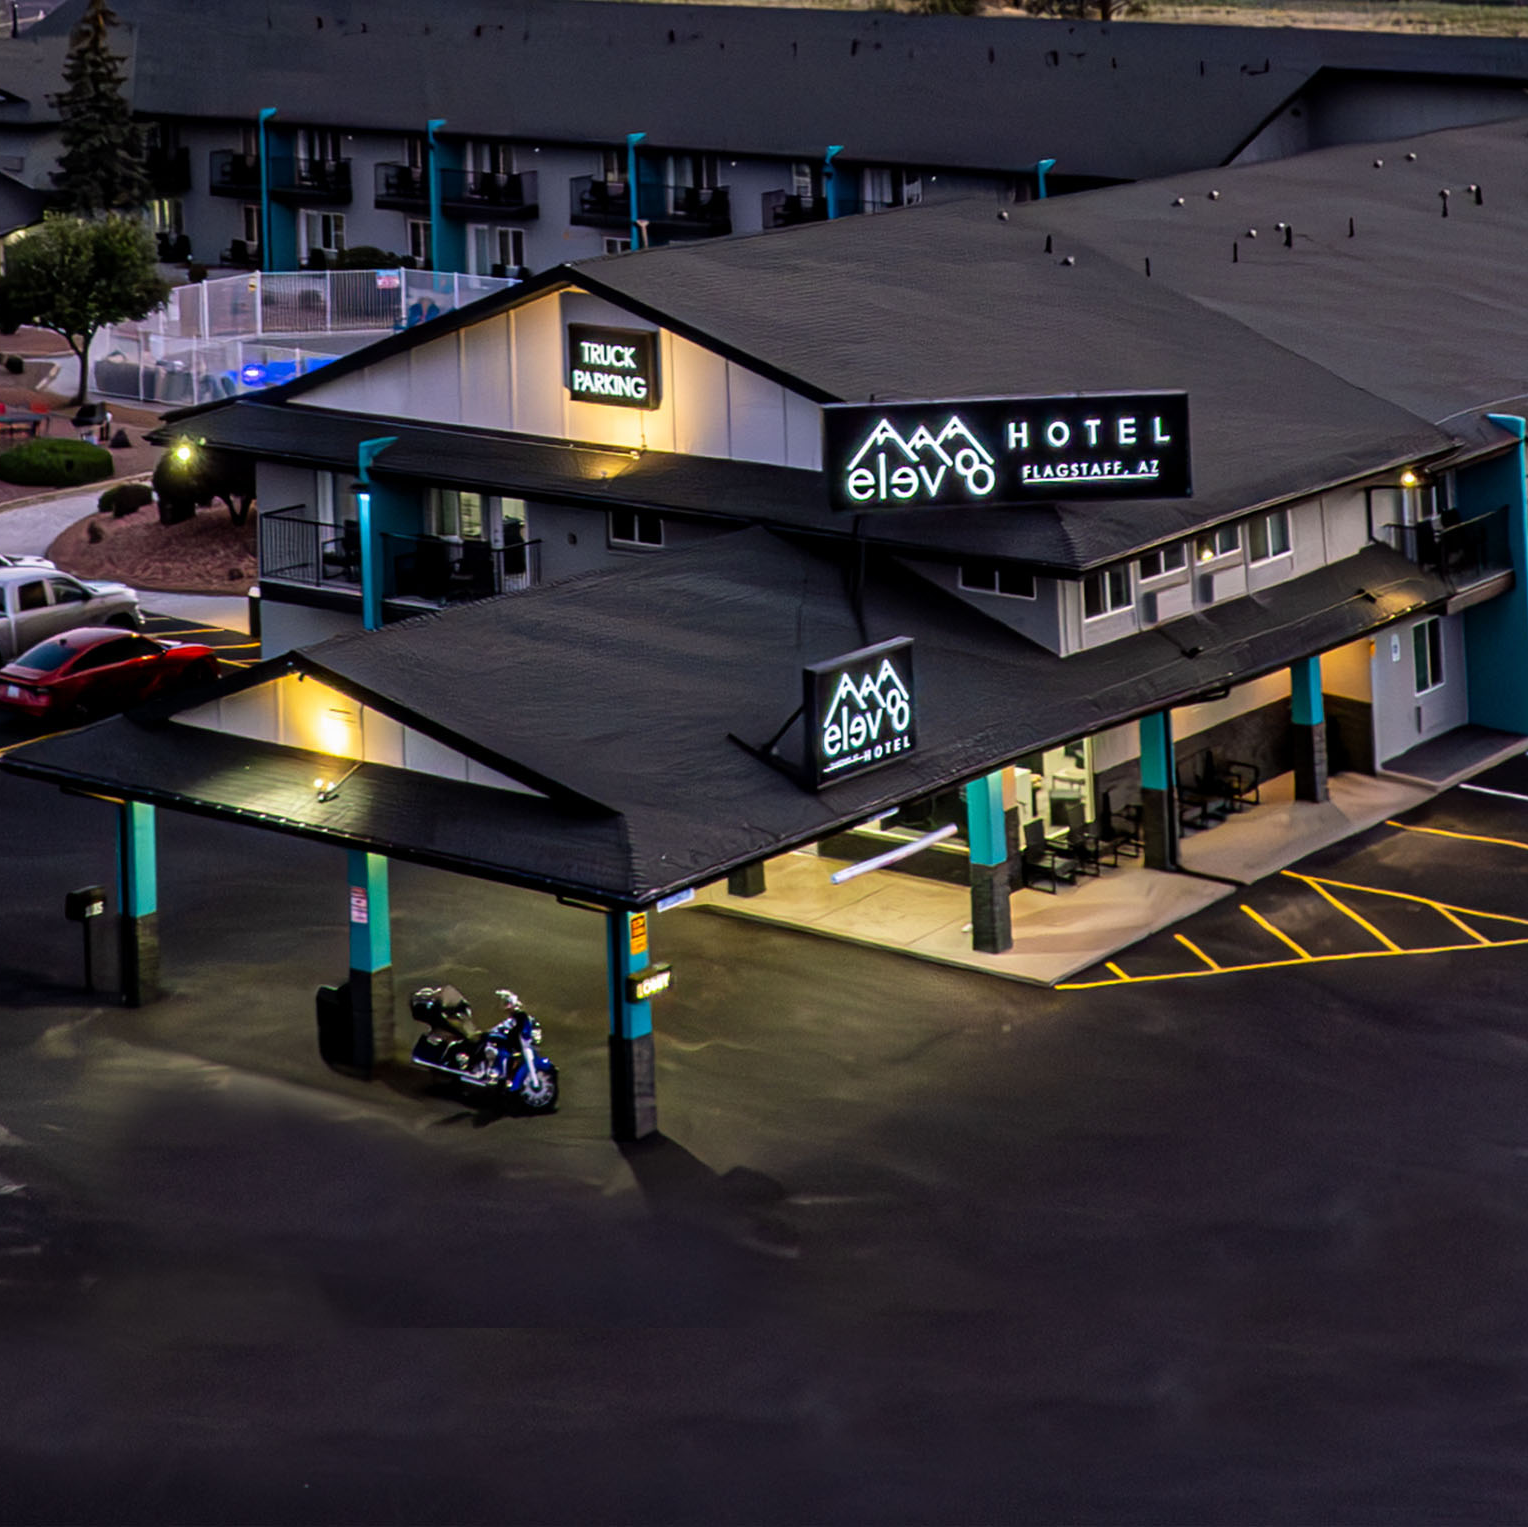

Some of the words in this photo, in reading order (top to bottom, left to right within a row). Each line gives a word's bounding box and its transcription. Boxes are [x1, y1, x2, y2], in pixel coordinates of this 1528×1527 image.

[580, 341, 636, 368] TRUCK
[573, 370, 647, 398] PARKING
[1008, 417, 1171, 449] HOTEL
[1023, 461, 1129, 478] FLAGSTAFF,
[1137, 459, 1160, 474] AZ
[864, 735, 911, 762] HOTEL
